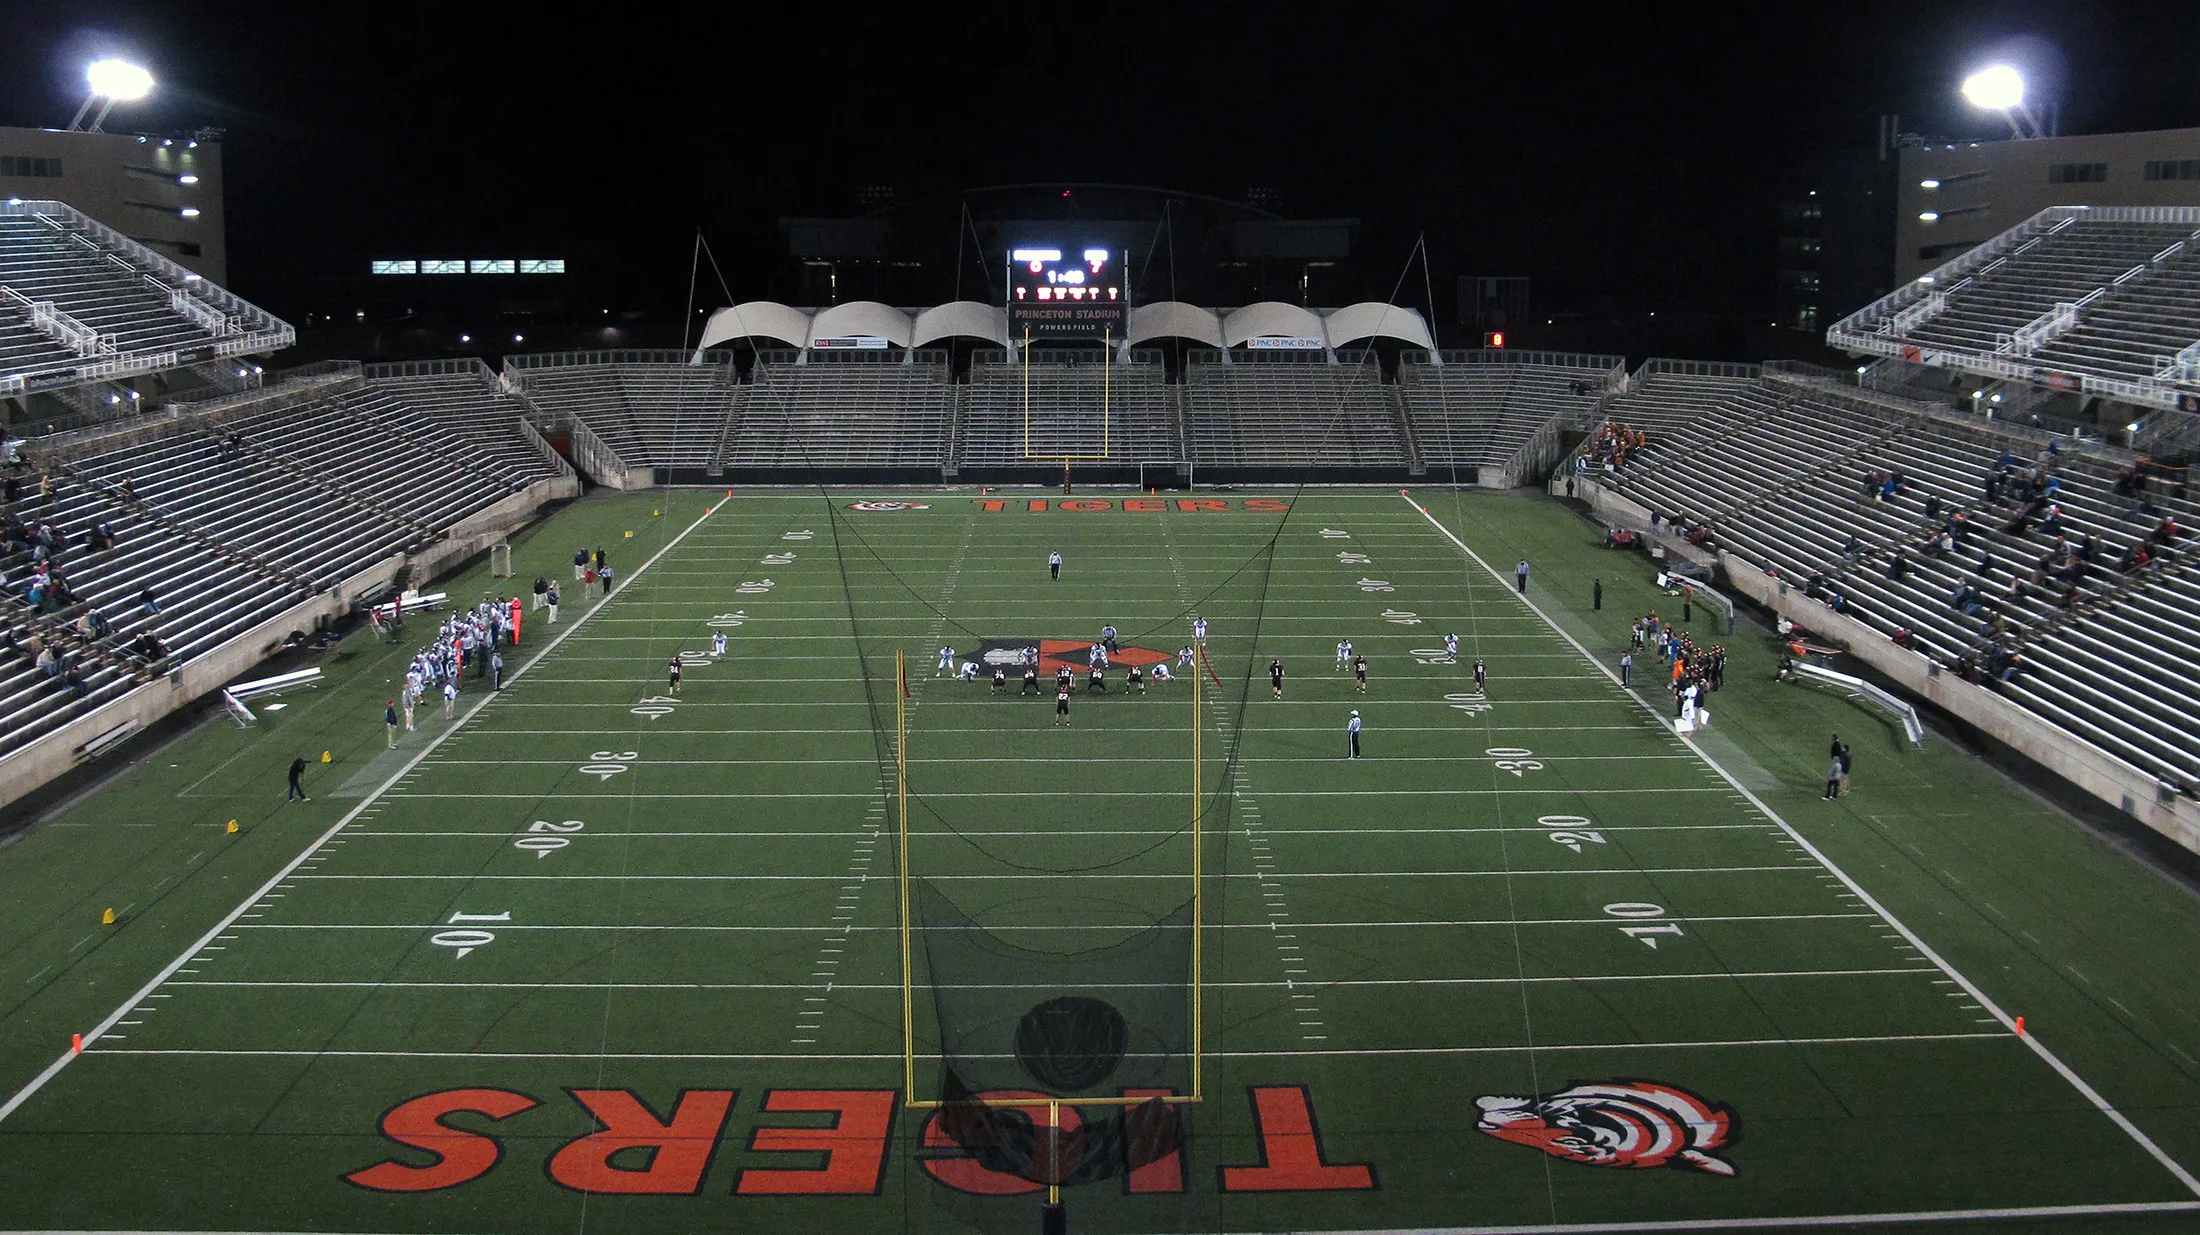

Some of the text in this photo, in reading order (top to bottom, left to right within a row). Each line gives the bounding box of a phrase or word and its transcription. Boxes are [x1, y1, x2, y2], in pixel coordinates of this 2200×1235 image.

[1015, 309, 1121, 319] PRINCETON STADIUM
[970, 498, 1291, 512] TIGERS
[578, 751, 638, 774] 30
[1484, 747, 1544, 770] 30
[513, 820, 584, 850] 20
[1537, 815, 1607, 844] 20
[430, 910, 512, 947] 10
[1602, 902, 1685, 938] 10
[345, 1084, 1380, 1198] TIGERS
